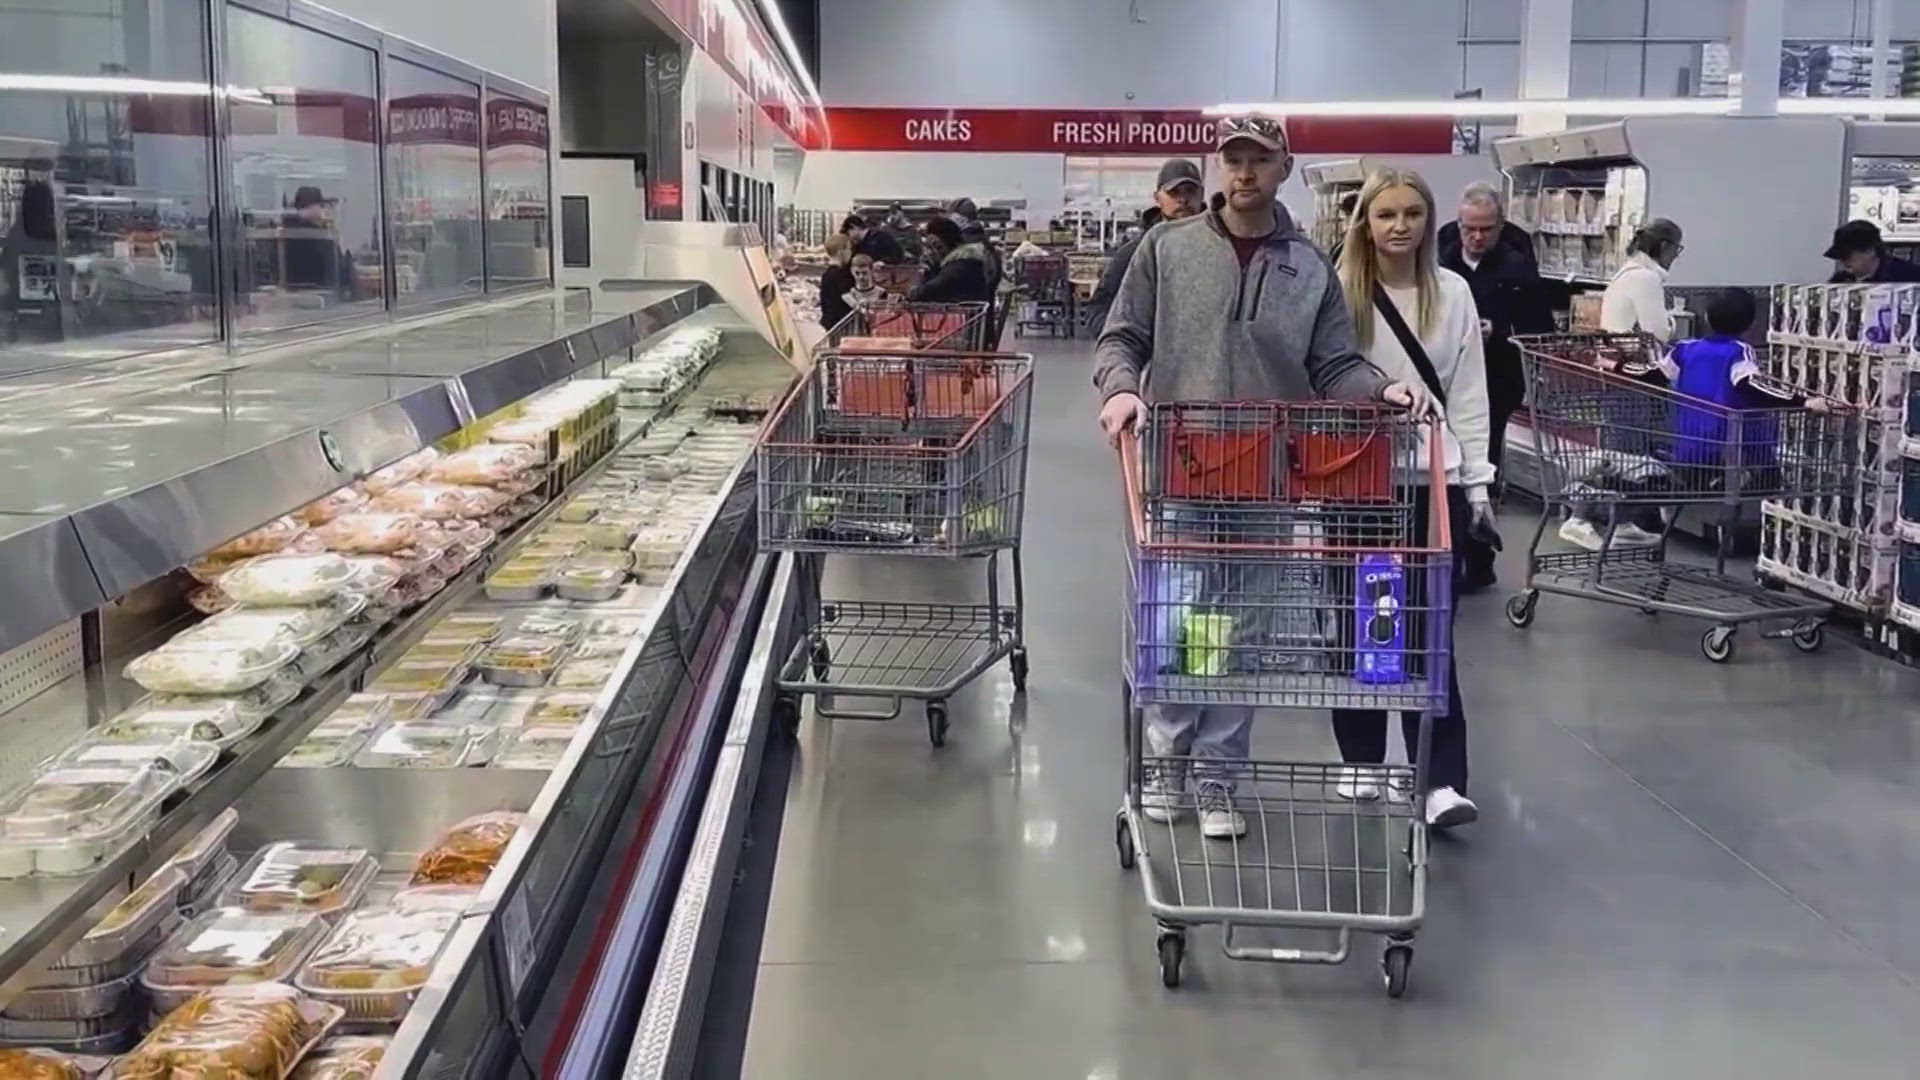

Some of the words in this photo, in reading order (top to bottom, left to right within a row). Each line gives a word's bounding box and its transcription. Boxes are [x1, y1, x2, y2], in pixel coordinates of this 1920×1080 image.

[905, 119, 971, 142] CAKES
[1053, 122, 1121, 144] FRESH
[1128, 122, 1221, 144] PRODUC
